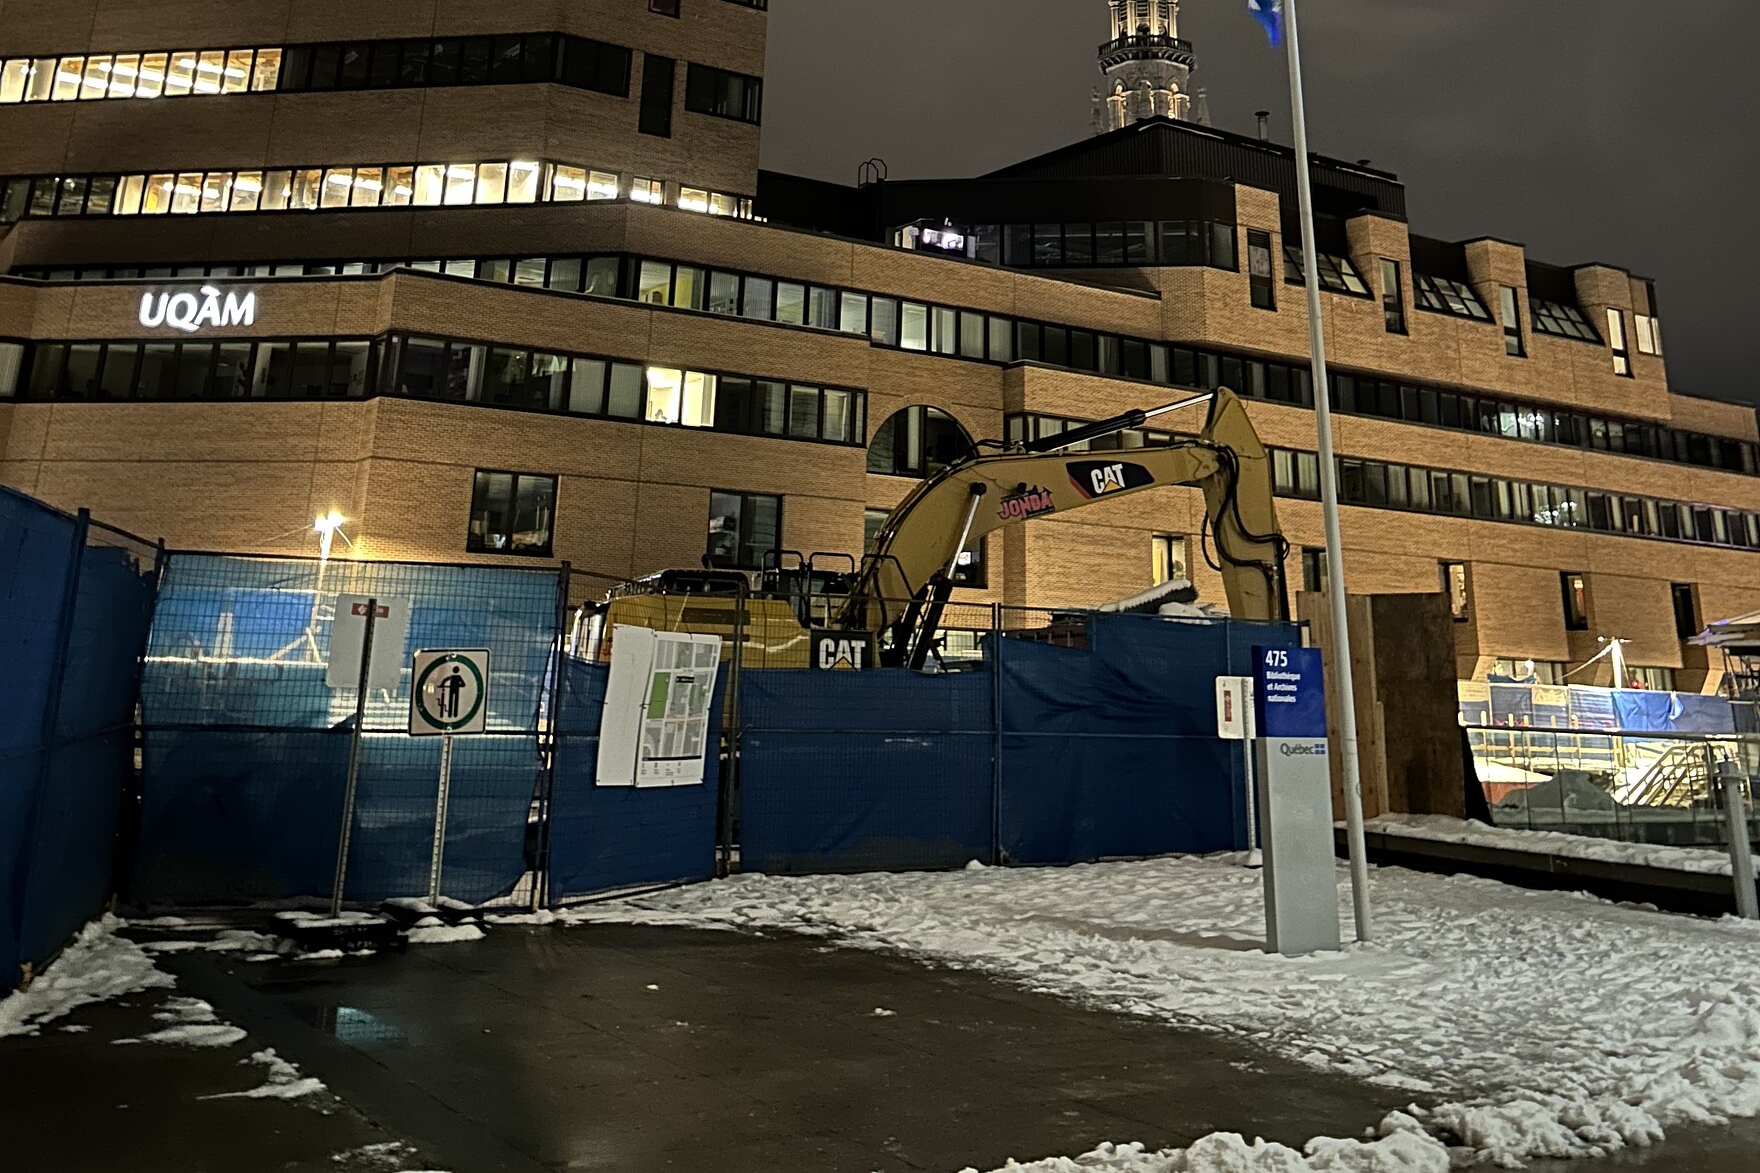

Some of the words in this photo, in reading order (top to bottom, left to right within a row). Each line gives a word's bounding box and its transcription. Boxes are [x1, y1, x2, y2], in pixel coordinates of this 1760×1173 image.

[1091, 463, 1125, 494] CAT
[999, 491, 1054, 520] JONDA
[819, 638, 866, 671] CAT
[1265, 650, 1288, 666] 475
[1266, 683, 1273, 691] et
[1274, 683, 1298, 692] Archives
[1267, 694, 1296, 703] nationales
[1280, 743, 1314, 756] Québec
